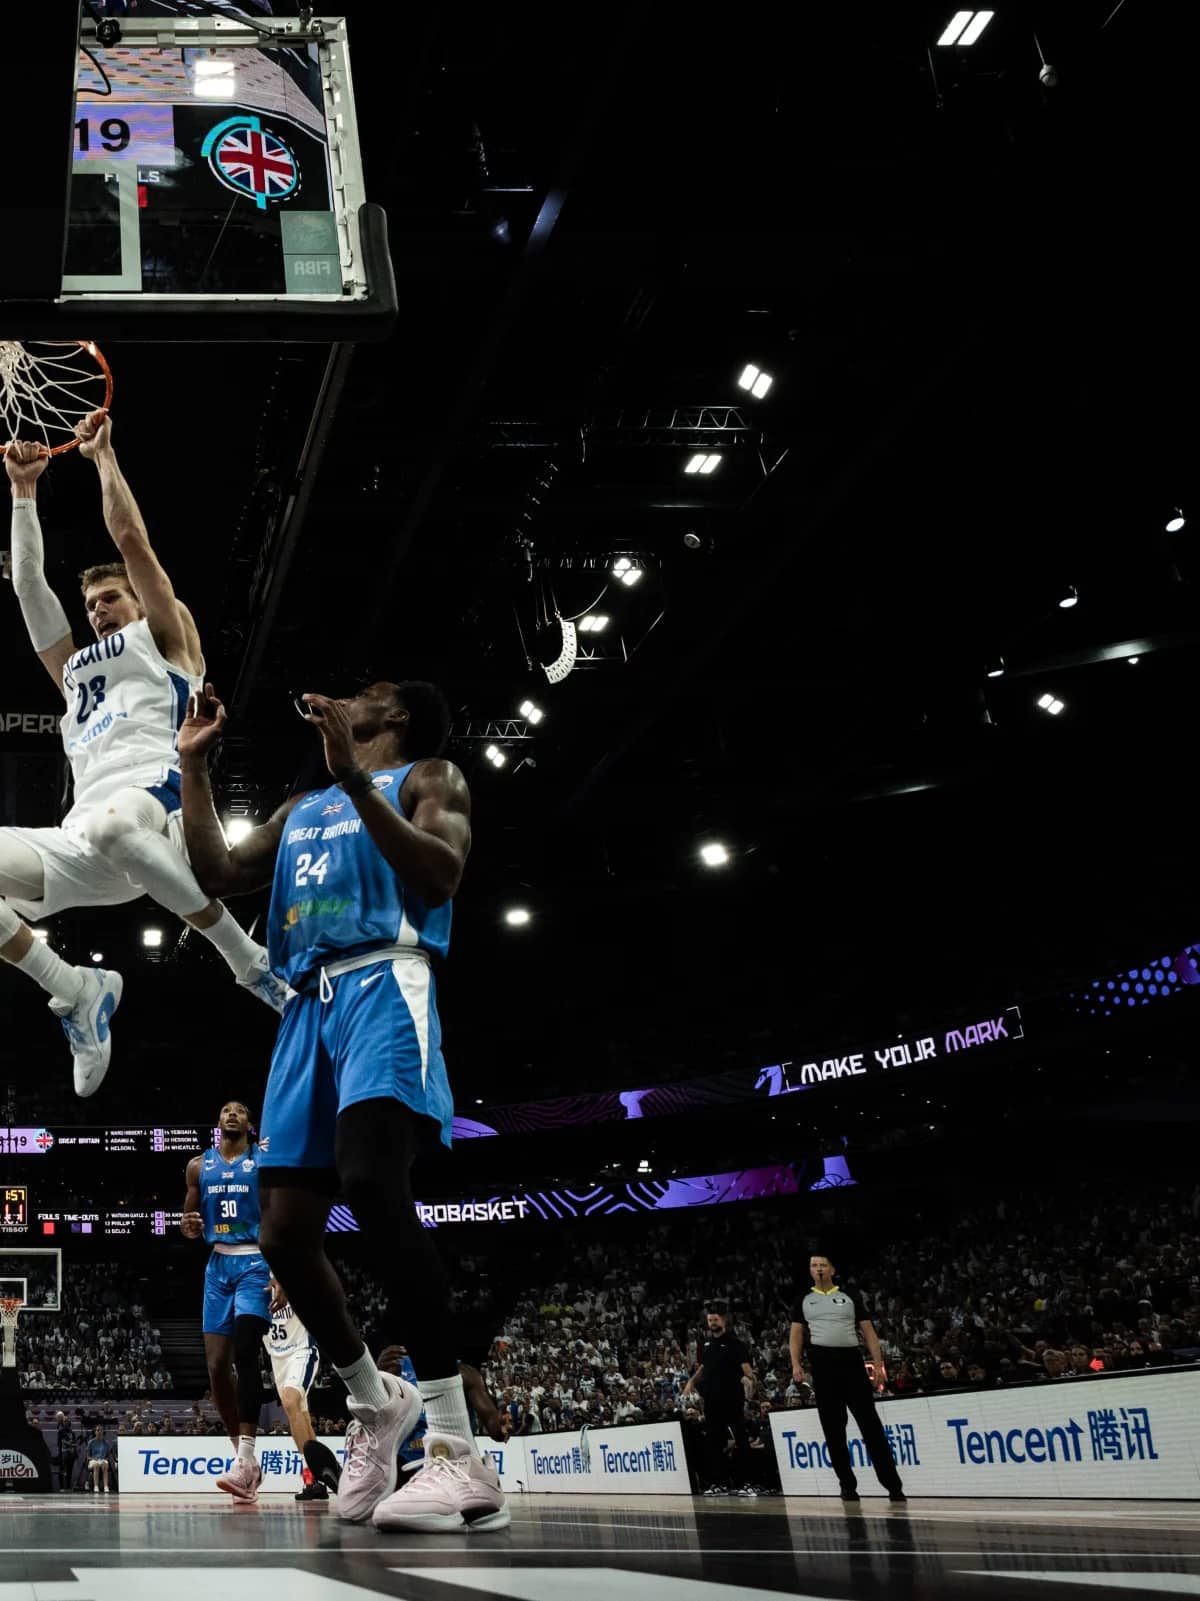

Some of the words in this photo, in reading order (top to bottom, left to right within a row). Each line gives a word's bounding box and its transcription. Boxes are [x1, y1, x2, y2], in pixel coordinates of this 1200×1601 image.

[75, 118, 130, 152] 19
[287, 827, 321, 845] GREAT
[321, 818, 362, 841] BRITAIN
[295, 851, 330, 887] 24
[801, 1053, 867, 1085] MAKE
[874, 1036, 937, 1071] YOUR
[944, 1016, 1009, 1054] MARK
[5, 1189, 25, 1201] 1:57
[220, 1200, 237, 1218] 30
[271, 1323, 287, 1341] 35
[946, 1418, 1085, 1465] Tencent
[1087, 1407, 1158, 1461] 腾讯
[138, 1449, 235, 1475] Tence
[531, 1449, 571, 1475] Tencent
[600, 1444, 651, 1473] Tencent
[652, 1440, 677, 1472] 腾讯
